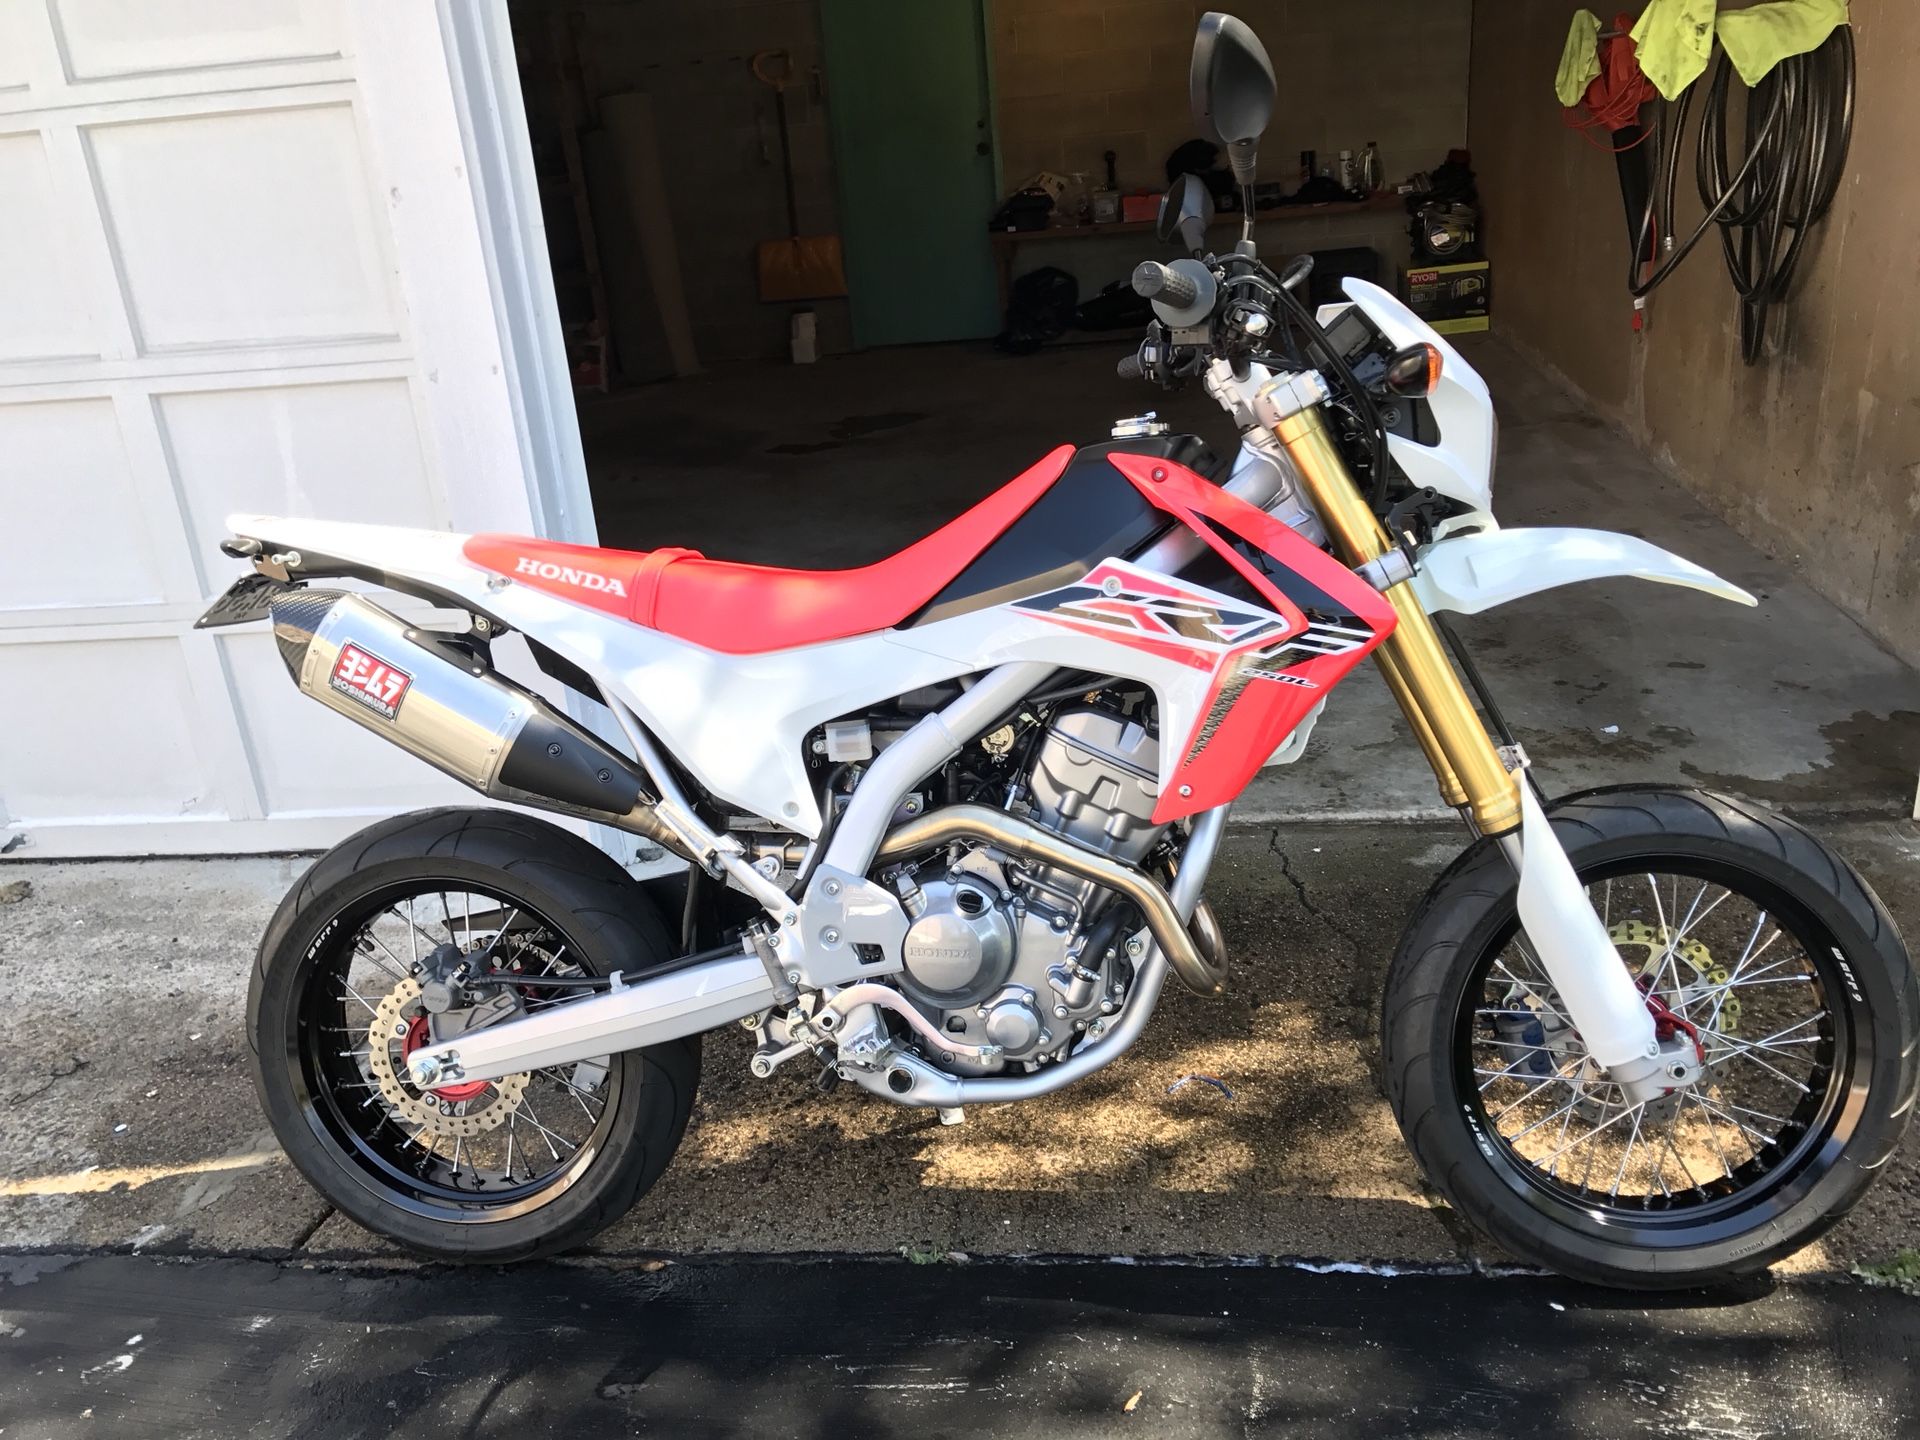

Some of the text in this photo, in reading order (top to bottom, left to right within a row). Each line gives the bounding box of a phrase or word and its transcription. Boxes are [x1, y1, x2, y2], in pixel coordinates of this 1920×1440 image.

[1411, 272, 1437, 283] RYOBI
[515, 557, 627, 598] HONDA
[333, 676, 395, 716] YOSHIMURA
[339, 649, 405, 703] ヨシムラ
[909, 946, 974, 960] HONDA
